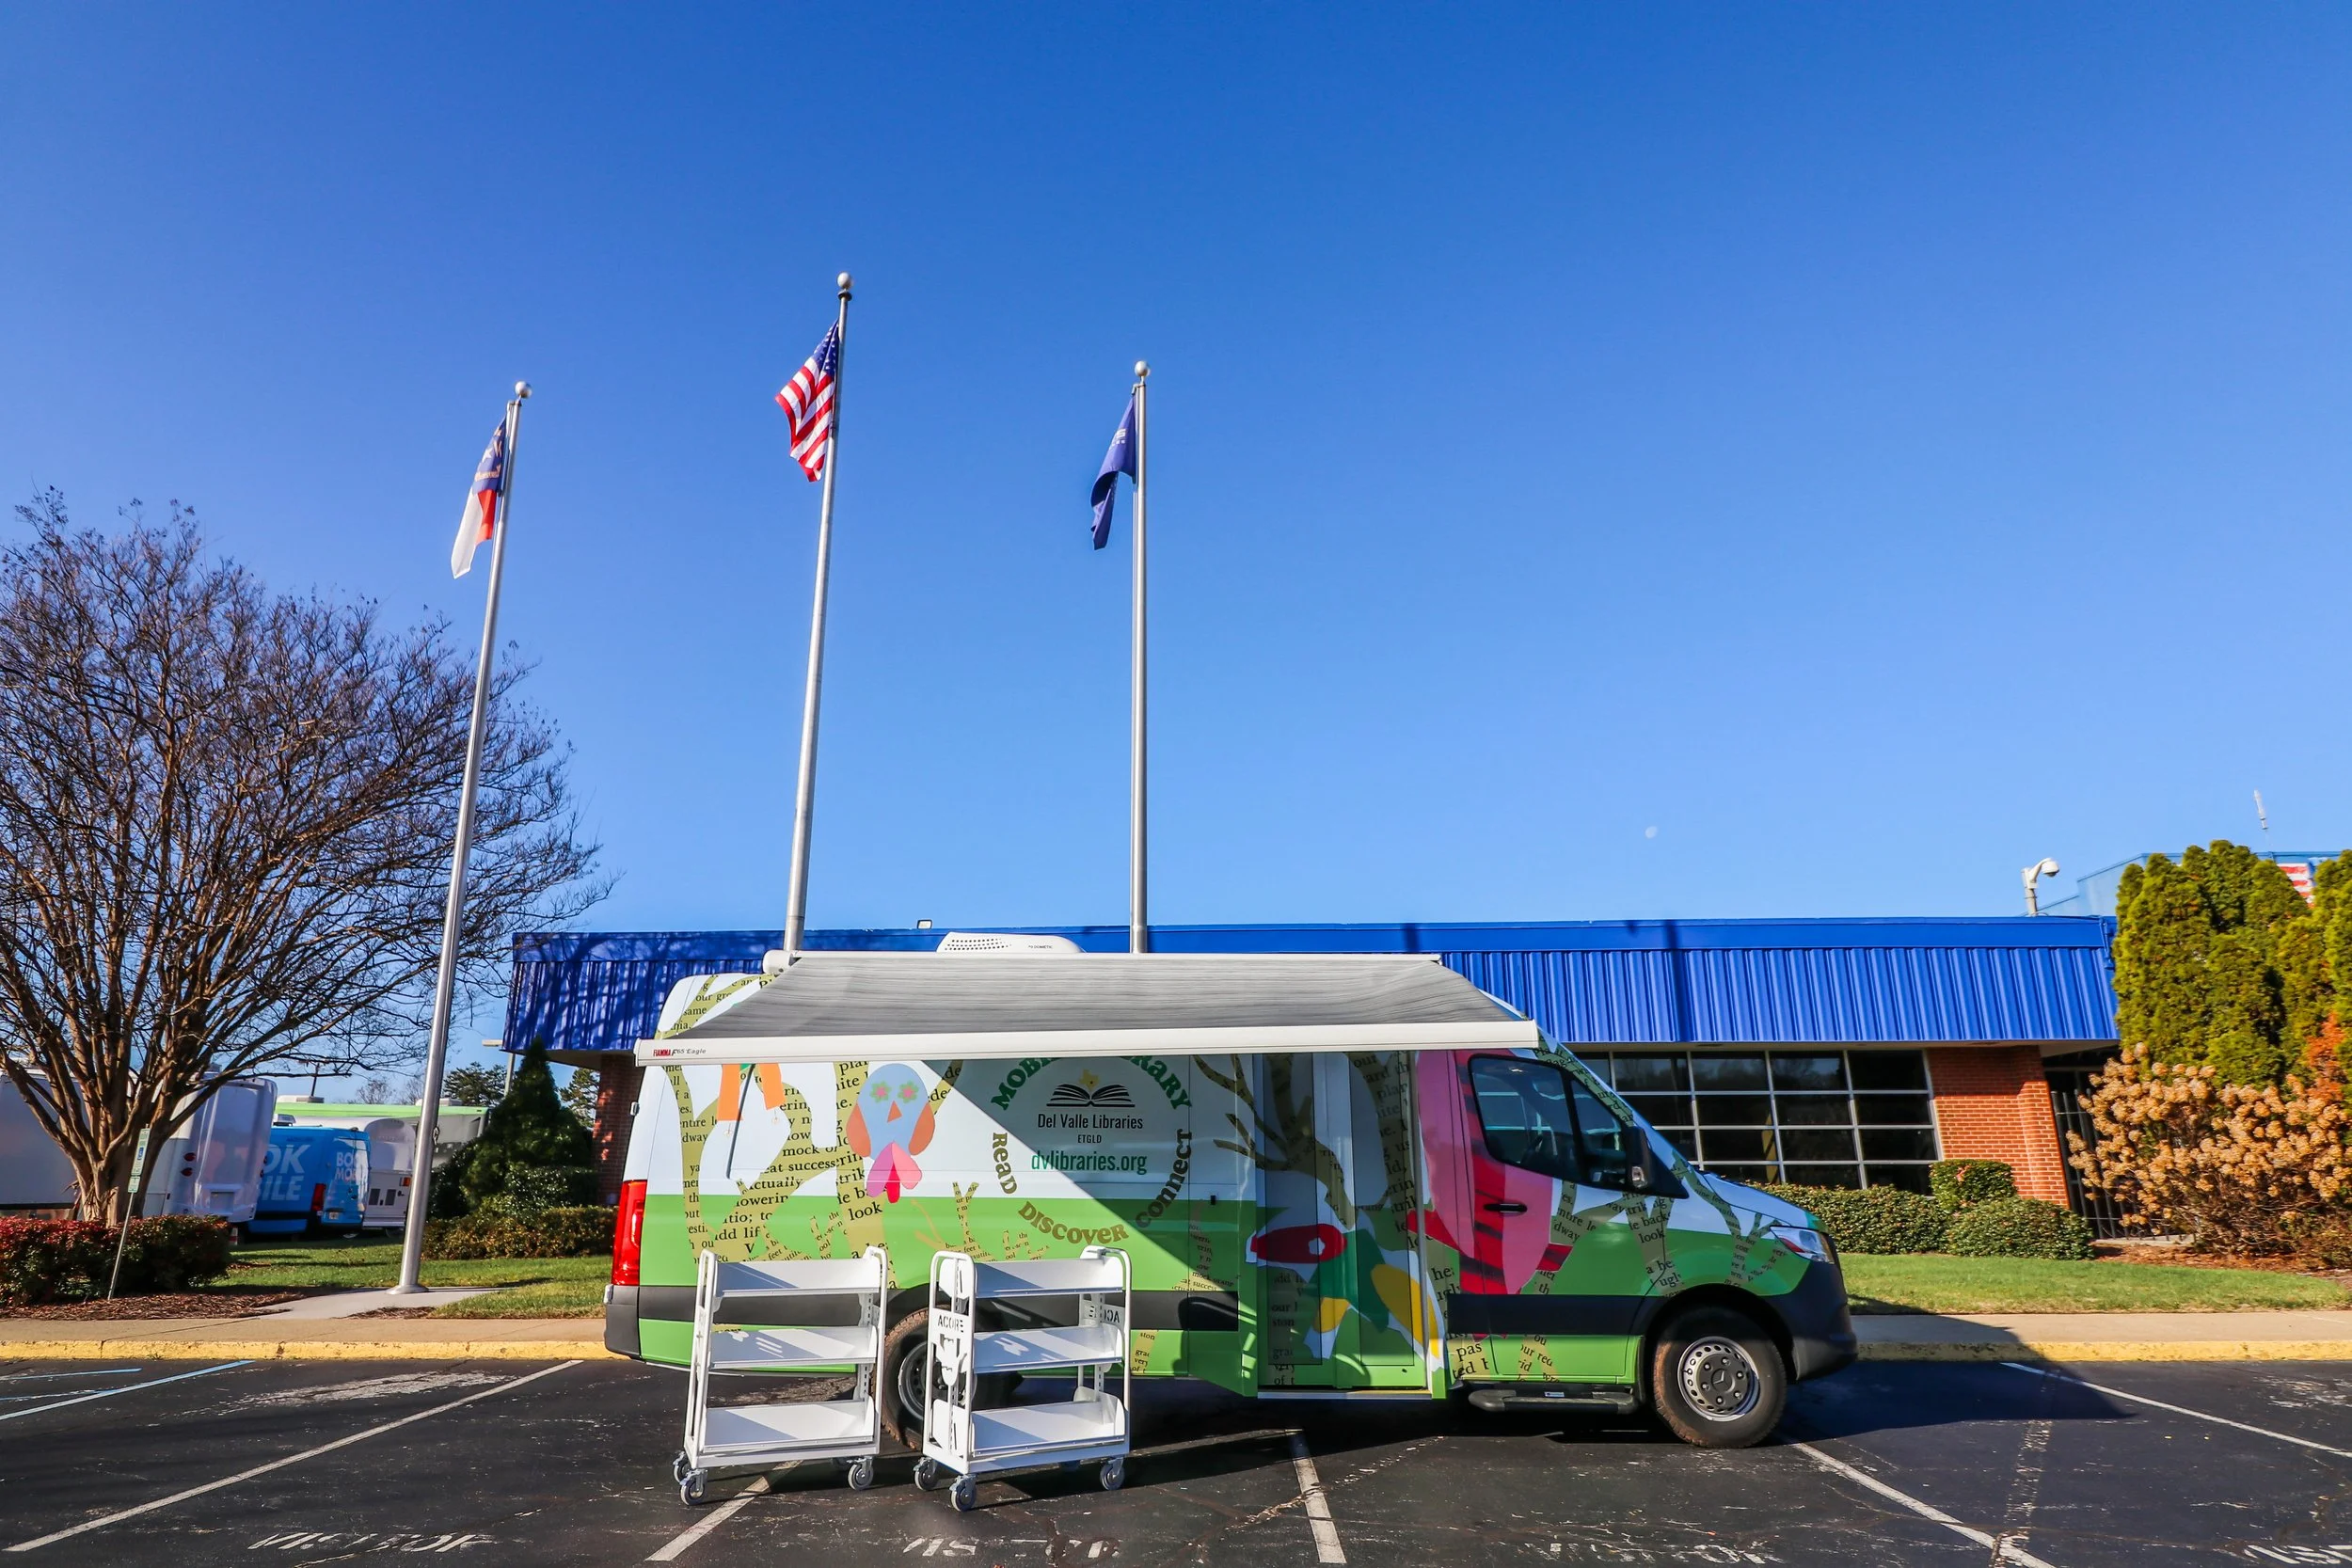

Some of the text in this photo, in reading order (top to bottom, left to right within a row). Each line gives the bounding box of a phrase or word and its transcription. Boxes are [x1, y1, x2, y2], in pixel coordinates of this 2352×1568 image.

[683, 1006, 707, 1016] same
[680, 1117, 707, 1128] ntire
[1038, 1114, 1143, 1129] Del Valle Libraries
[1077, 1134, 1102, 1144] ETGLD
[783, 1145, 820, 1156] mock
[1031, 1150, 1147, 1175] dvlibraries.org
[849, 1202, 882, 1221] look
[1638, 1227, 1665, 1243] look
[937, 1314, 964, 1333] ACORE
[1456, 1342, 1483, 1362] pas
